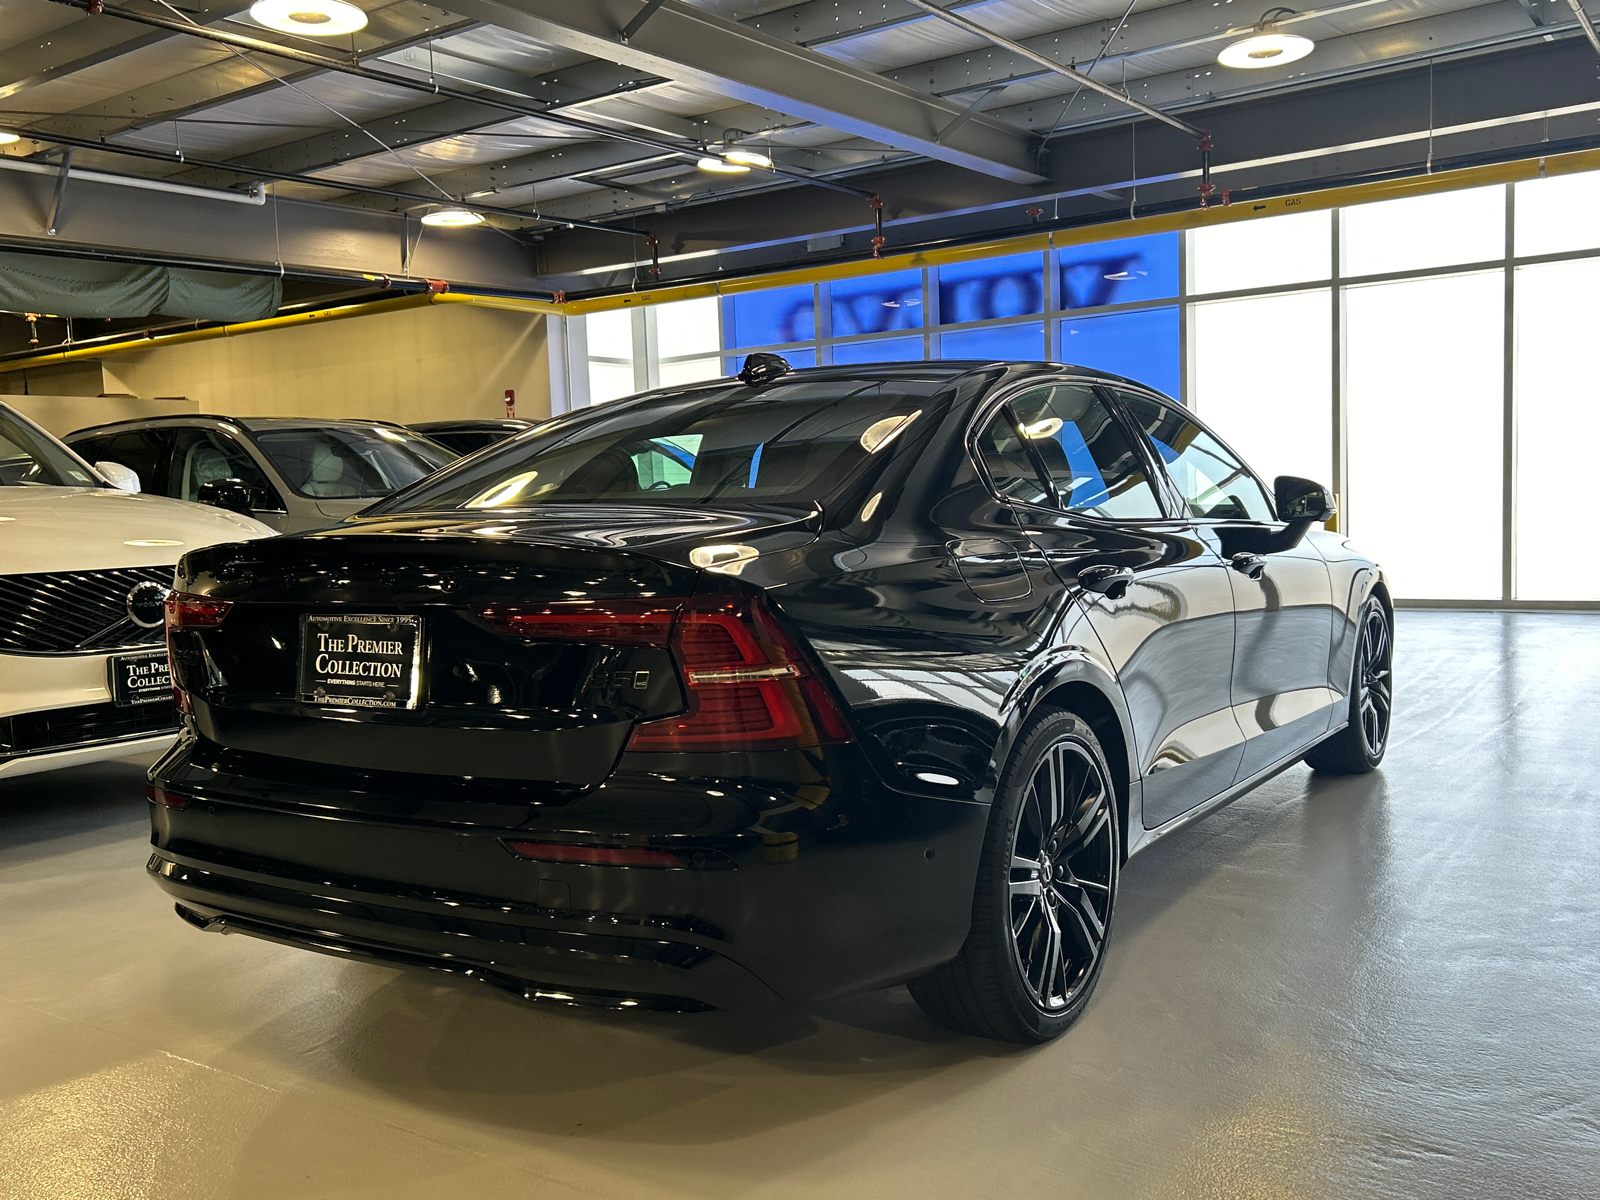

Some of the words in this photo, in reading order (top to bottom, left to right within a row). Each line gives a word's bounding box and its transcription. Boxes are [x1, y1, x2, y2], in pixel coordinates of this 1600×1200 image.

[1285, 198, 1302, 207] GAS
[317, 633, 345, 653] THE
[347, 634, 403, 655] PREMIER
[126, 665, 150, 676] THE
[315, 654, 402, 678] COLLECTION
[127, 676, 171, 688] COLLEC
